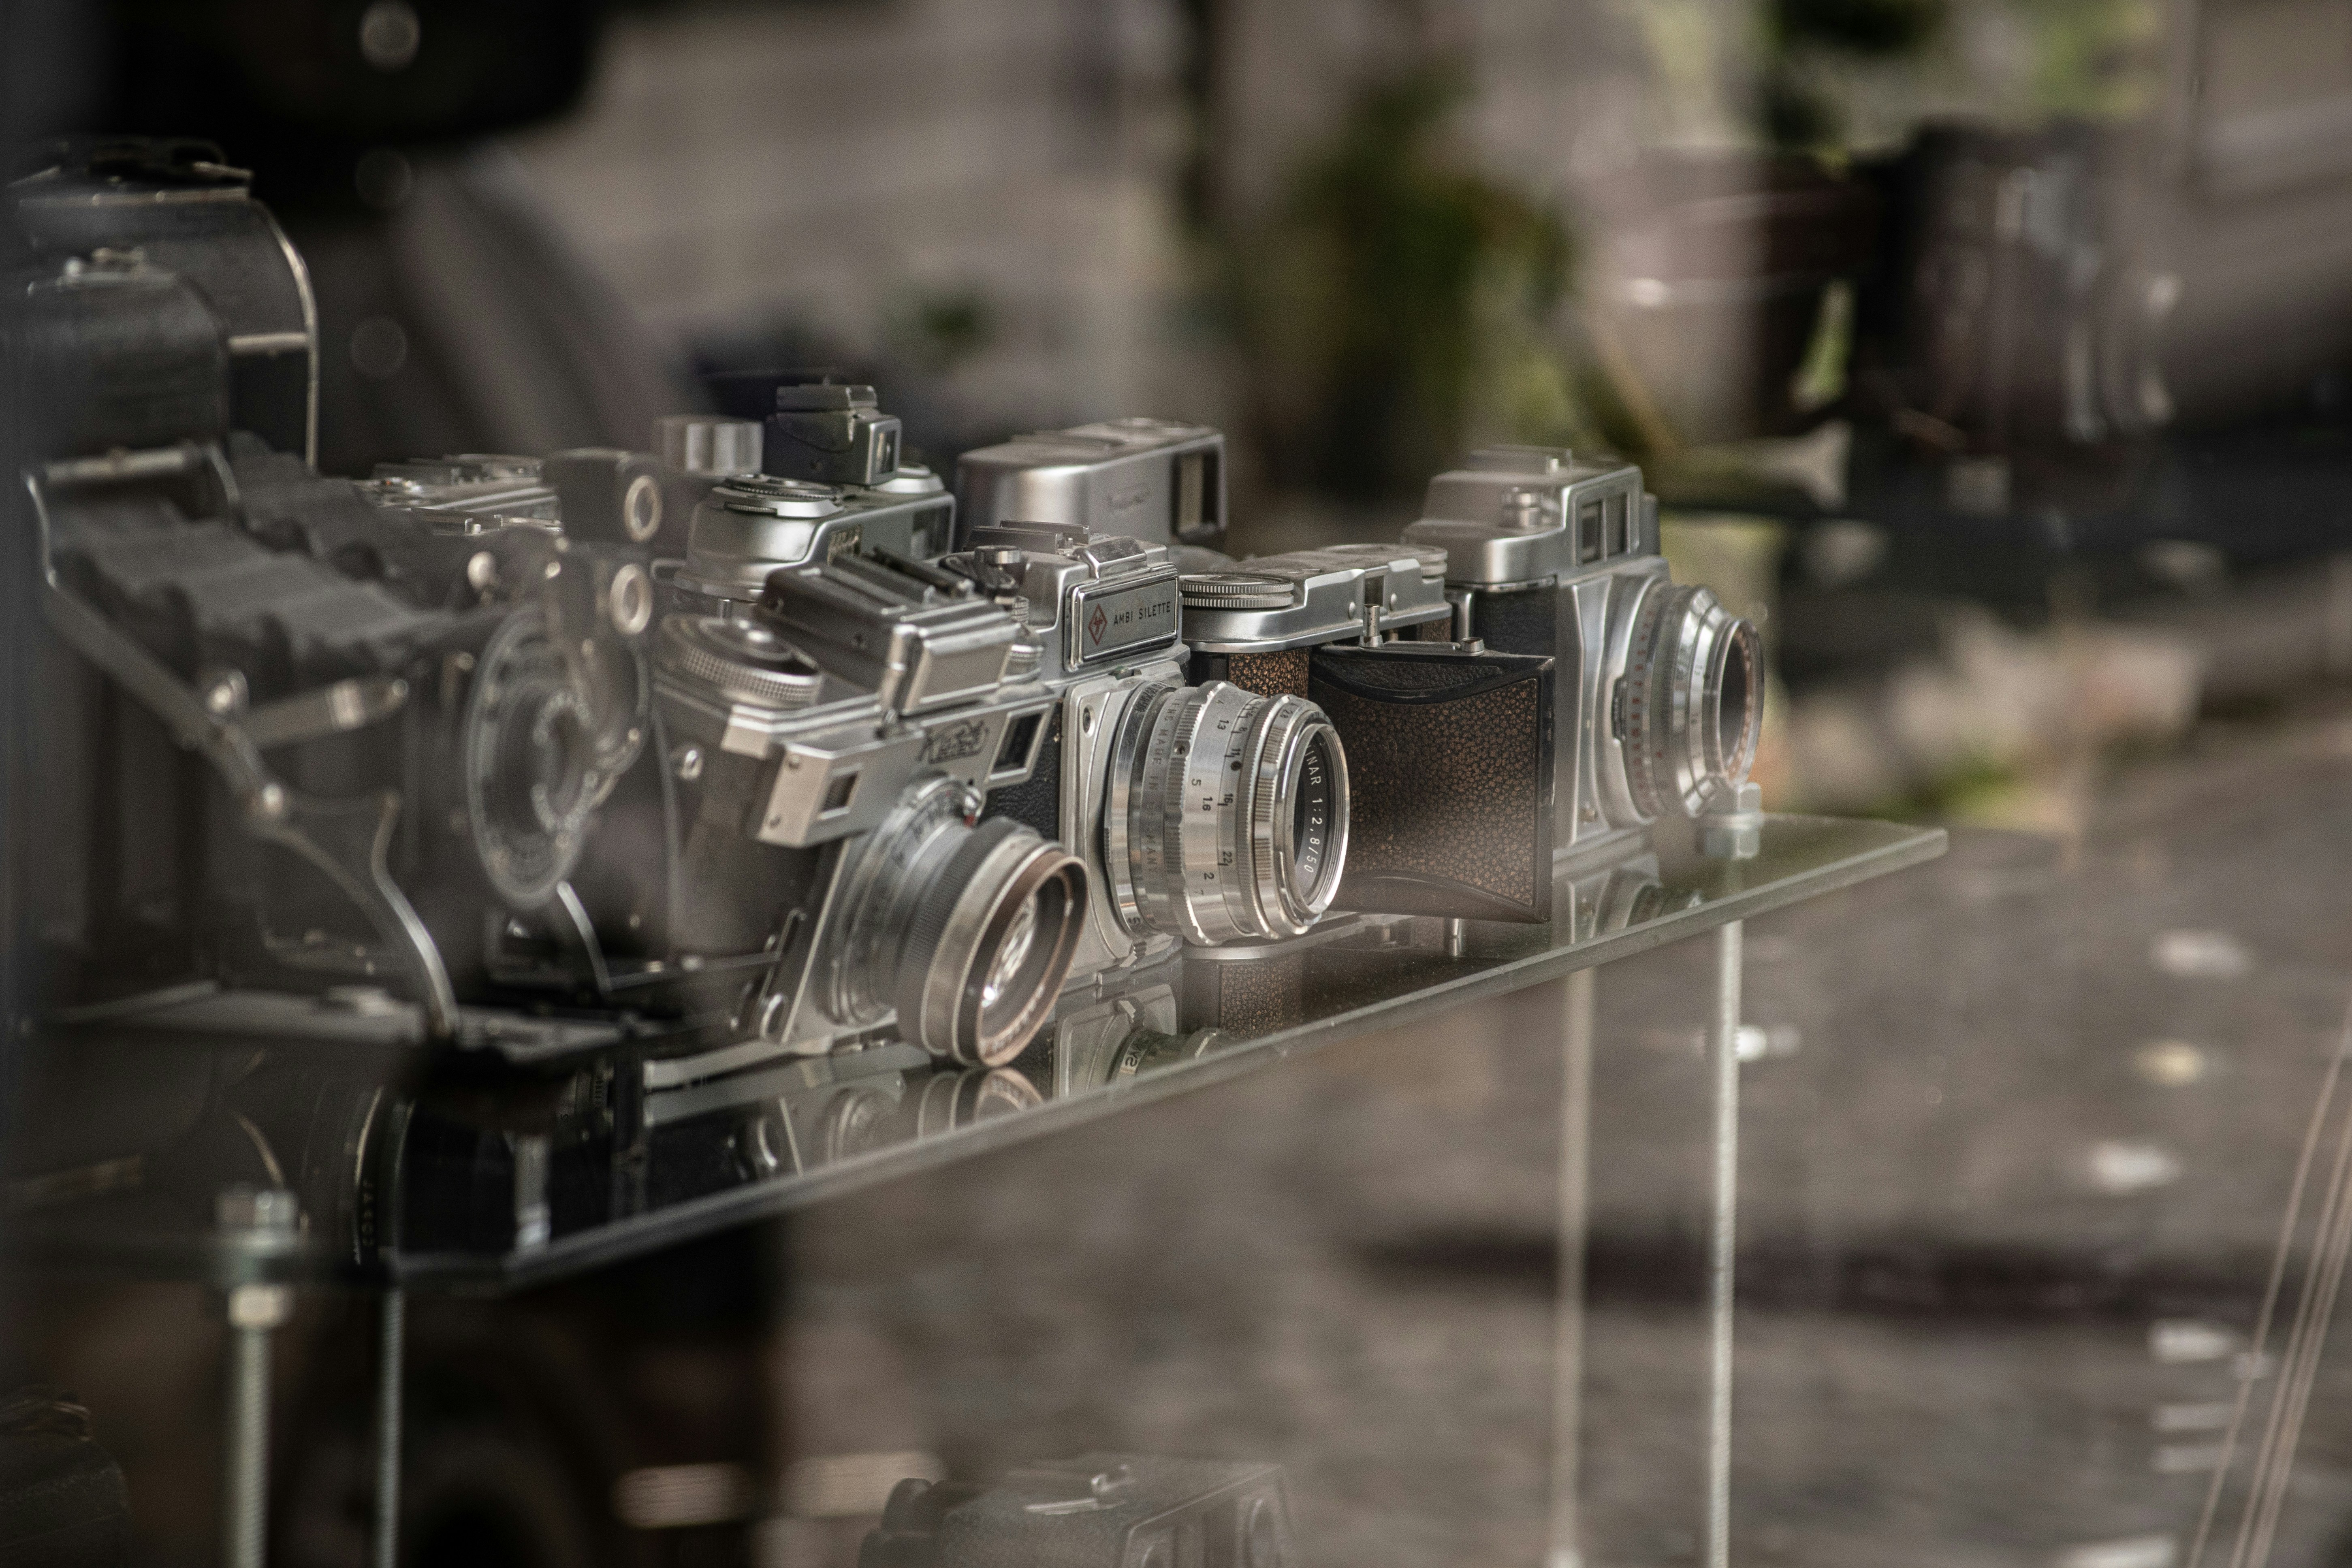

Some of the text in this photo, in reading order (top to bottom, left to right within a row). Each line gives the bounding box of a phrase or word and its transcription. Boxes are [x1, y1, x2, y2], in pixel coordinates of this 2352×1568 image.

[1114, 610, 1133, 625] AMBI
[1139, 601, 1170, 619] SILETTE
[1153, 729, 1169, 765] MADE
[1149, 776, 1158, 789] IN
[1191, 778, 1201, 786] 5
[1202, 796, 1213, 811] 1.6
[1223, 793, 1233, 804] 16
[1222, 851, 1232, 864] 22
[1204, 872, 1214, 880] 2
